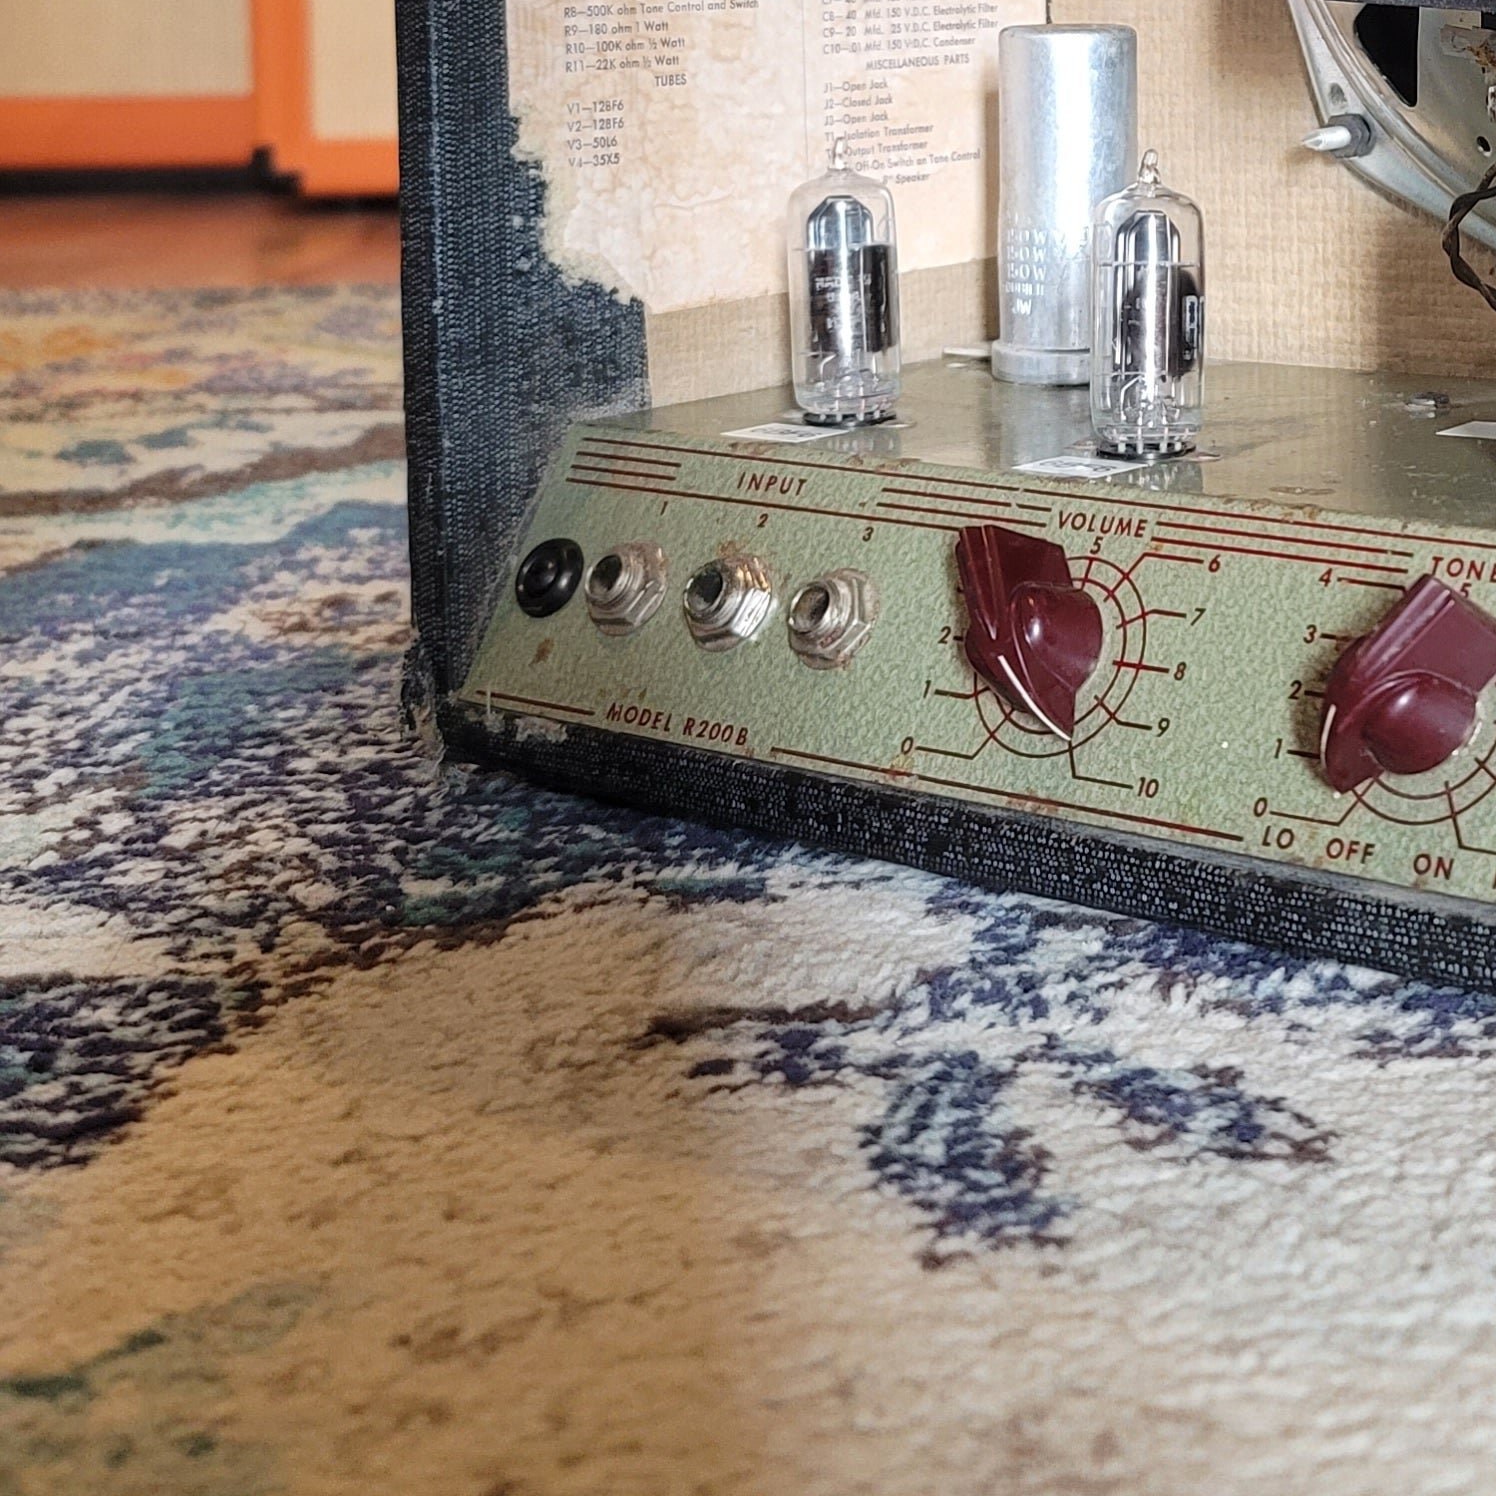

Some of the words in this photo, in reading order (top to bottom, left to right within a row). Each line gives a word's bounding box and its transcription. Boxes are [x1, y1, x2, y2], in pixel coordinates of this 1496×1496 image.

[617, 5, 636, 16] ohm
[641, 3, 663, 14] Tone
[668, 1, 704, 12] Control
[708, 0, 726, 10] and
[933, 6, 976, 16] Electrolytic
[978, 4, 998, 14] Filter
[612, 24, 632, 34] ohm
[644, 21, 668, 31] Watt
[933, 21, 976, 32] Electrolytic
[978, 20, 998, 29] Filter
[626, 41, 644, 51] ohm
[660, 38, 685, 49] Watt
[934, 37, 975, 47] Condenser
[620, 58, 640, 69] ohm
[655, 56, 679, 66] Watt
[866, 56, 939, 70] MISCELLANEOUS
[944, 54, 969, 65] PARTS
[655, 75, 687, 87] TUBES
[870, 79, 888, 89] Jack
[875, 96, 893, 106] Jack
[870, 112, 888, 122] Jack
[884, 123, 933, 137] Transformer
[878, 140, 928, 153] Transformer
[888, 155, 914, 168] Switch
[930, 152, 948, 164] Tone
[951, 149, 981, 162] Control
[896, 172, 930, 184] Speaker
[737, 472, 807, 496] INPUT
[660, 501, 667, 515] 1
[758, 514, 768, 528] 2
[1058, 511, 1148, 537] VOLUME
[863, 527, 873, 542] 3
[1091, 538, 1102, 554] 5
[1209, 556, 1220, 572] 6
[1319, 568, 1333, 586] 4
[1461, 584, 1471, 597] 5
[1190, 608, 1205, 625] 7
[939, 626, 951, 643] 2
[1304, 626, 1316, 643] 3
[1174, 663, 1186, 680] 8
[924, 681, 931, 697] 1
[1289, 681, 1301, 699] 2
[607, 703, 672, 732] MODEL
[683, 717, 748, 745] R200B
[1157, 718, 1169, 736] 9
[901, 737, 913, 754] 0
[1274, 739, 1281, 757] 1
[1138, 778, 1158, 795] 10
[1254, 799, 1267, 816] 0
[1262, 826, 1294, 849] LO
[1326, 838, 1375, 864] OFF
[1414, 854, 1454, 879] ON
